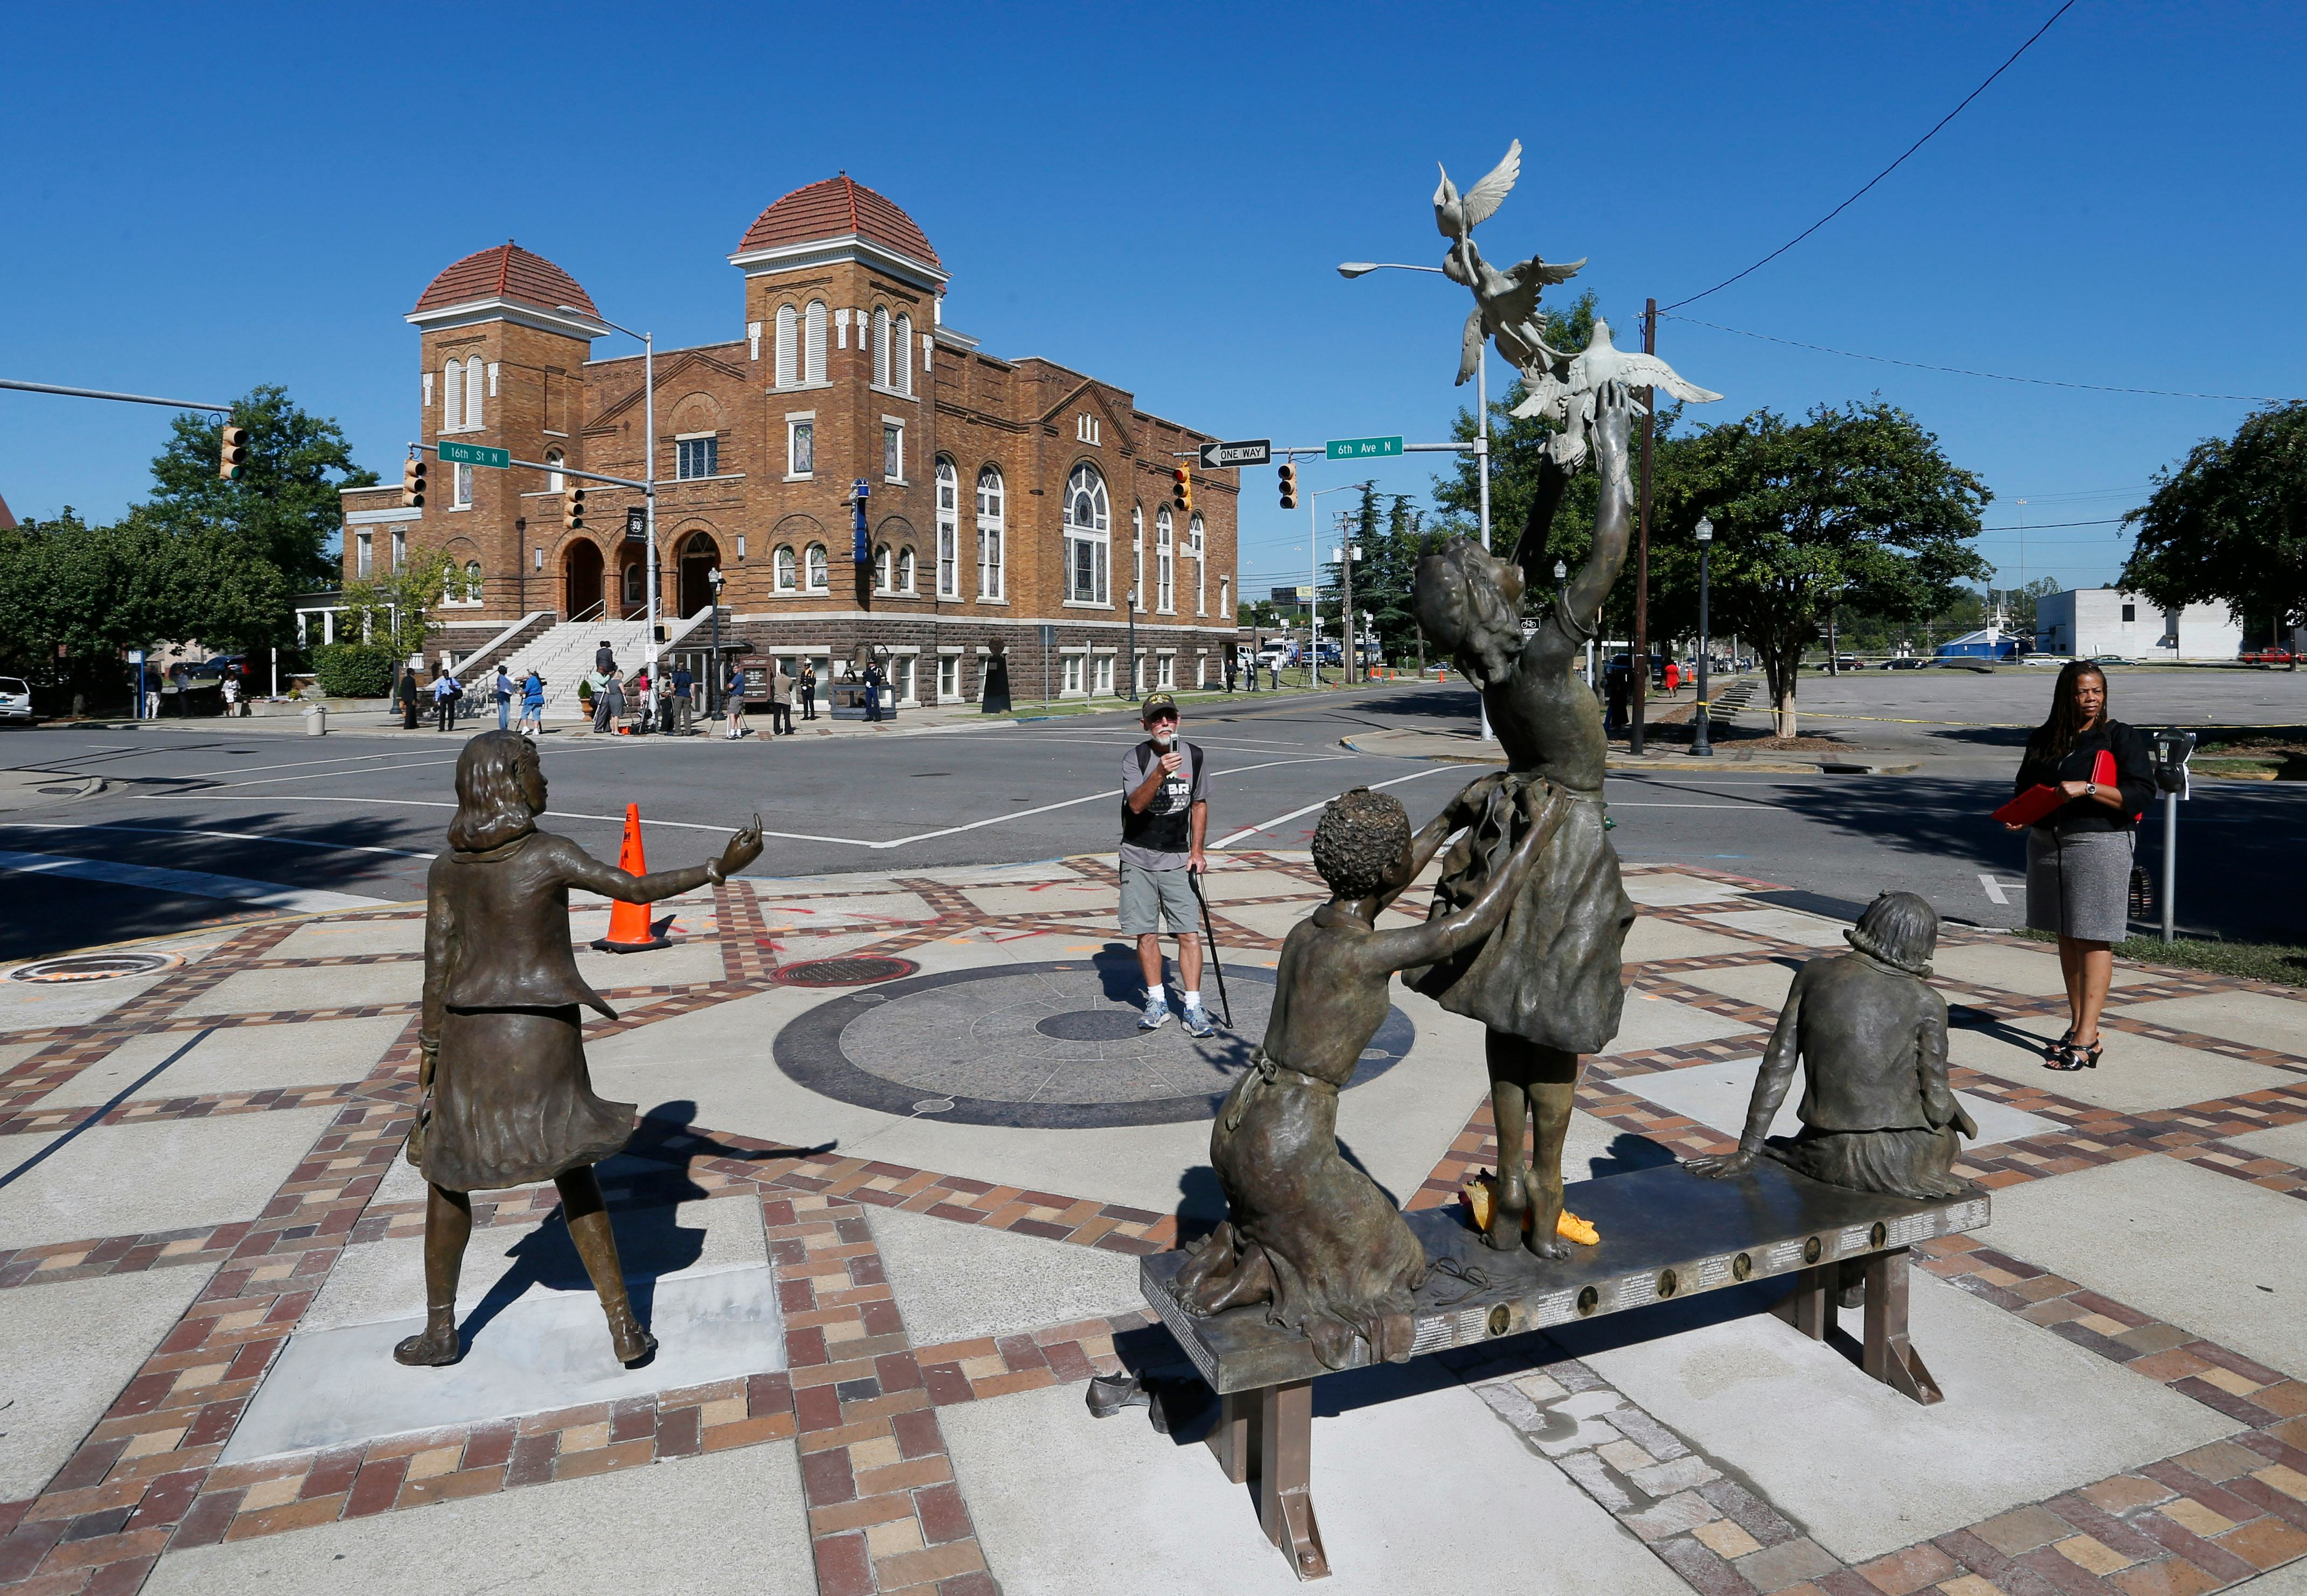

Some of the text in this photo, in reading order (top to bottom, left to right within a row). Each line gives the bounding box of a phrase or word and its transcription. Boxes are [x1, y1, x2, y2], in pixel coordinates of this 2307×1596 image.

[1221, 447, 1261, 459] ONE WAY
[1338, 442, 1390, 454] 6th Ave N
[451, 447, 498, 463] 16th St N
[632, 521, 640, 530] 50
